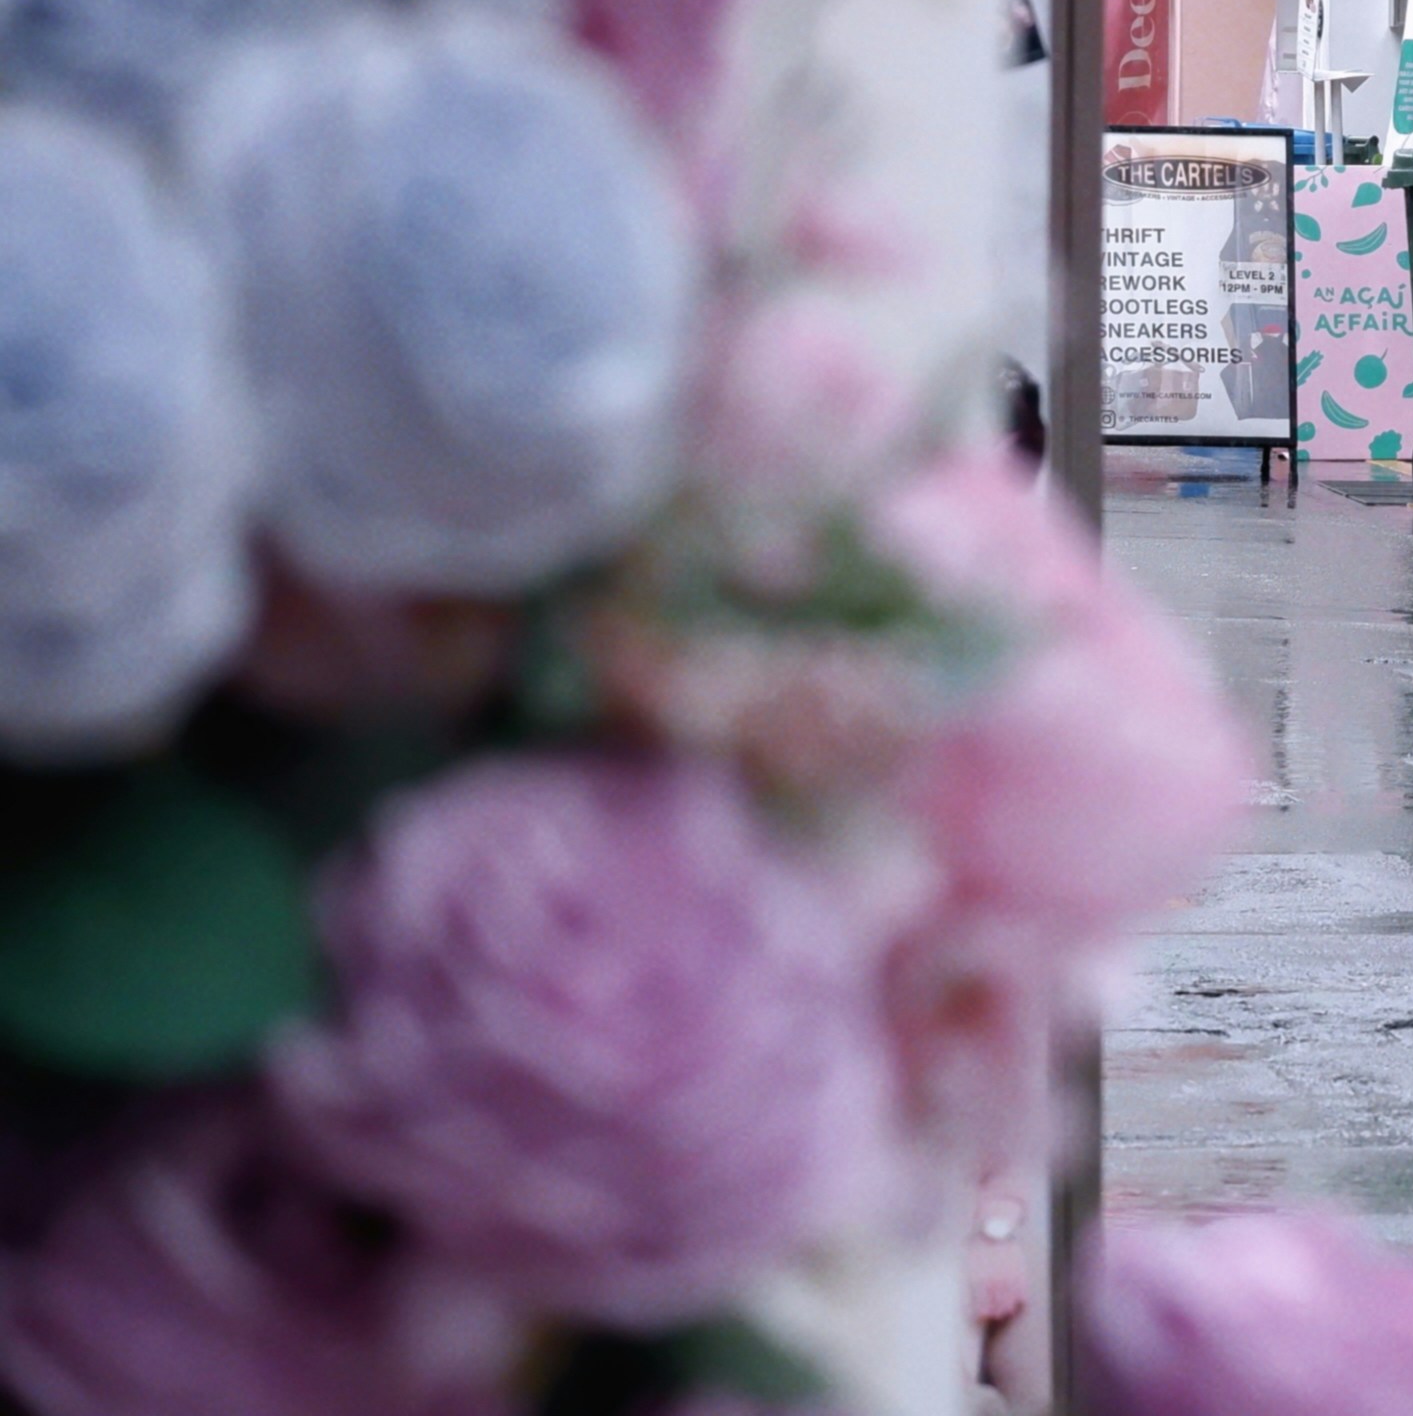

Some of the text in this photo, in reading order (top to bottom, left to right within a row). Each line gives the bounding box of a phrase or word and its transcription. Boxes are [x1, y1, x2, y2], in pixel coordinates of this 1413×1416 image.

[1117, 164, 1156, 185] THE
[1228, 269, 1276, 282] LEVEL 2
[1221, 283, 1252, 294] 12PM
[1260, 284, 1284, 295] 9PM
[1313, 286, 1335, 303] AN
